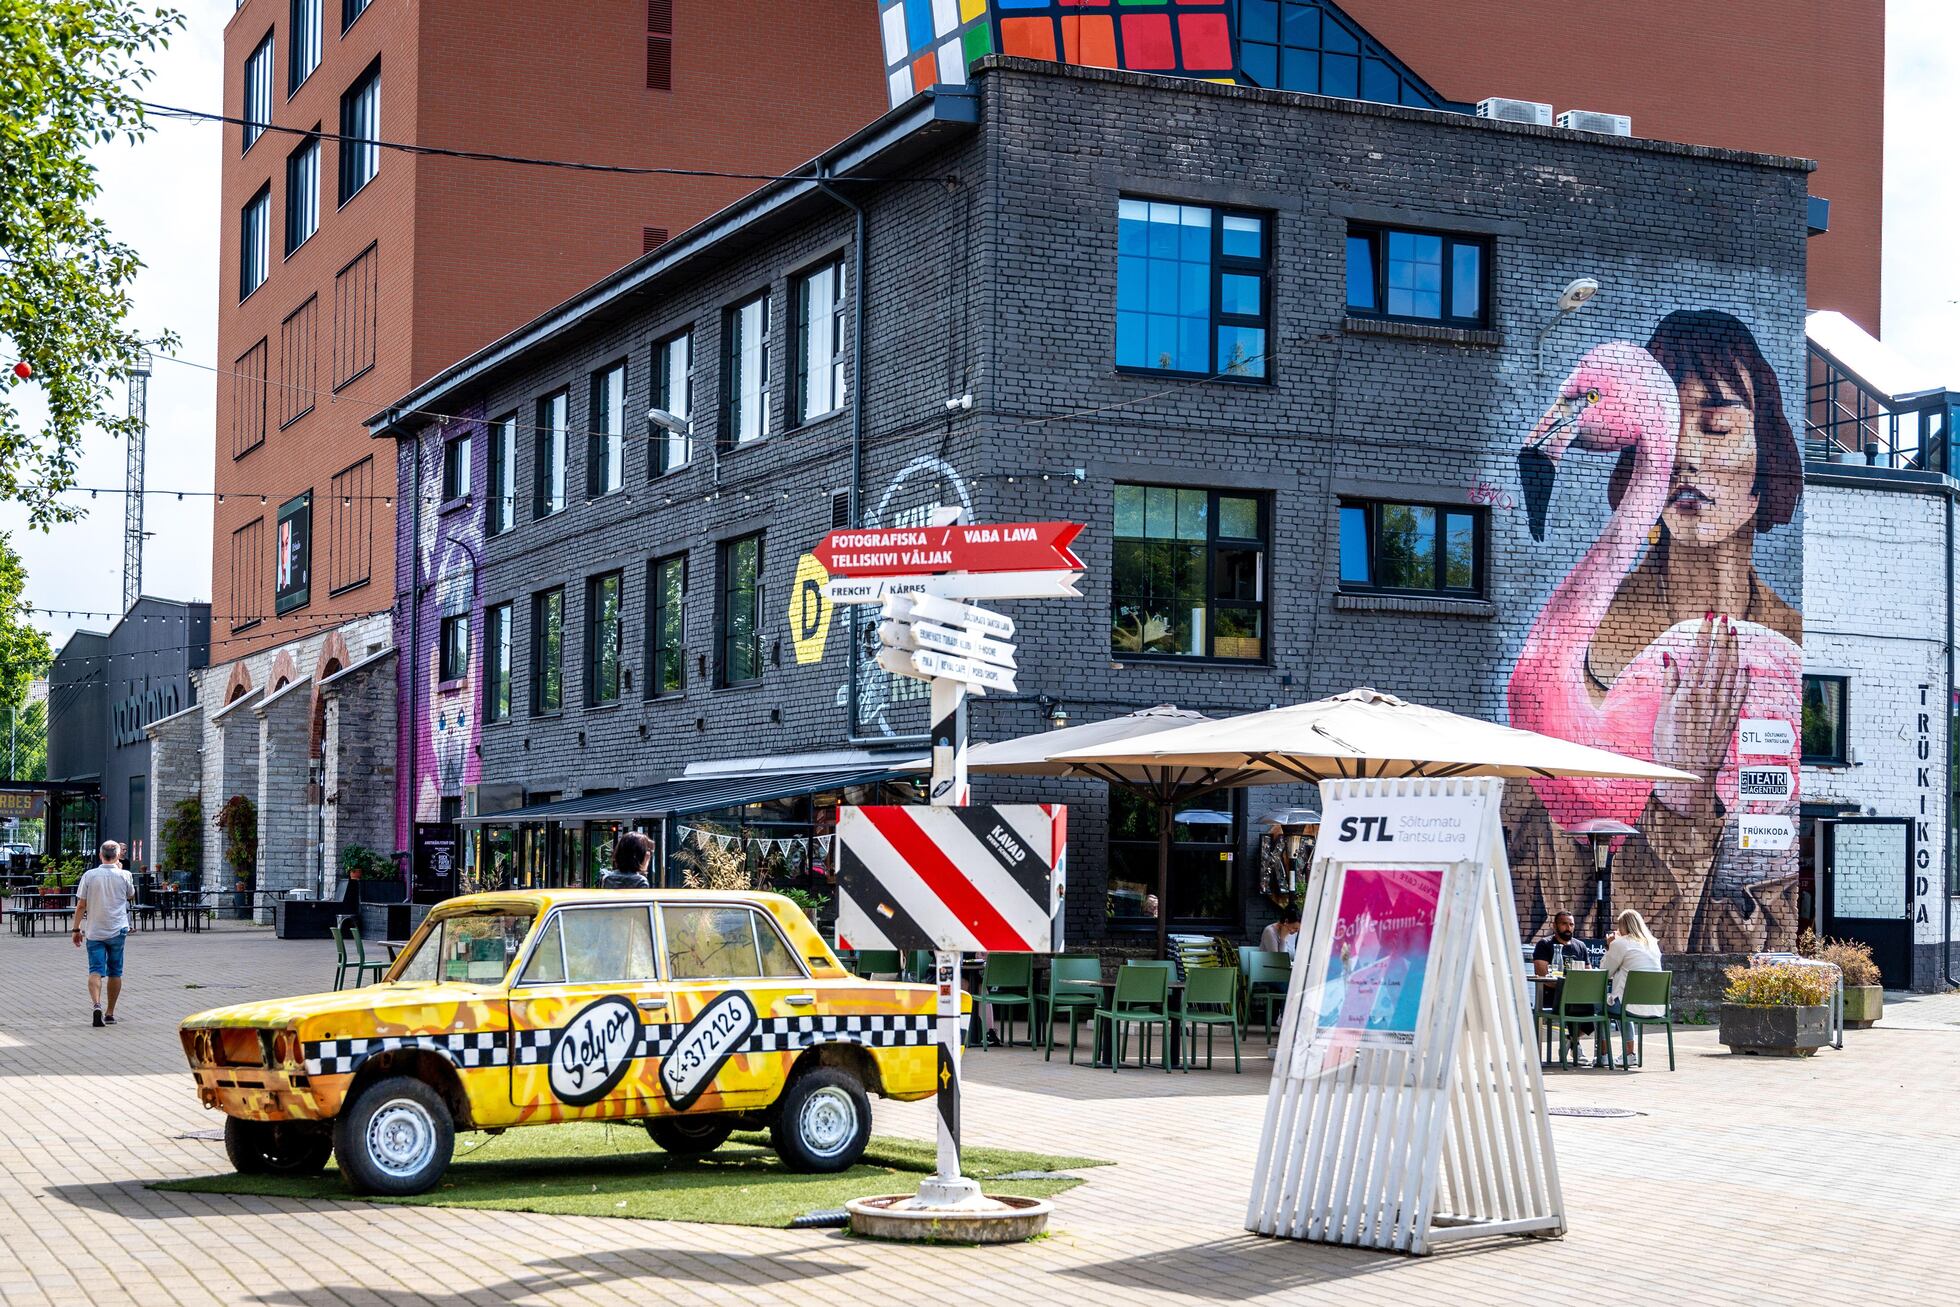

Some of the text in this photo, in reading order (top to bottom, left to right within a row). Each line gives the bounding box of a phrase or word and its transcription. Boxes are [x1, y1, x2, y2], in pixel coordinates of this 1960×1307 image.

[831, 532, 928, 549] FOTOGRAFISKA
[964, 530, 999, 544] VABA
[1003, 528, 1038, 542] LAVA
[831, 552, 898, 568] TELLISKIVI
[831, 586, 872, 596] FRENCHY
[1741, 731, 1762, 743] STL
[1749, 772, 1787, 785] TEATRI
[1748, 786, 1788, 794] AGENTUUR
[1915, 684, 1930, 924] TRÜKIKODA
[1338, 815, 1461, 842] STL Sõltumatu
[1742, 826, 1789, 836] TRÜKIKODA
[990, 824, 1026, 862] KAVAD
[1397, 831, 1466, 843] Tantsu Lava
